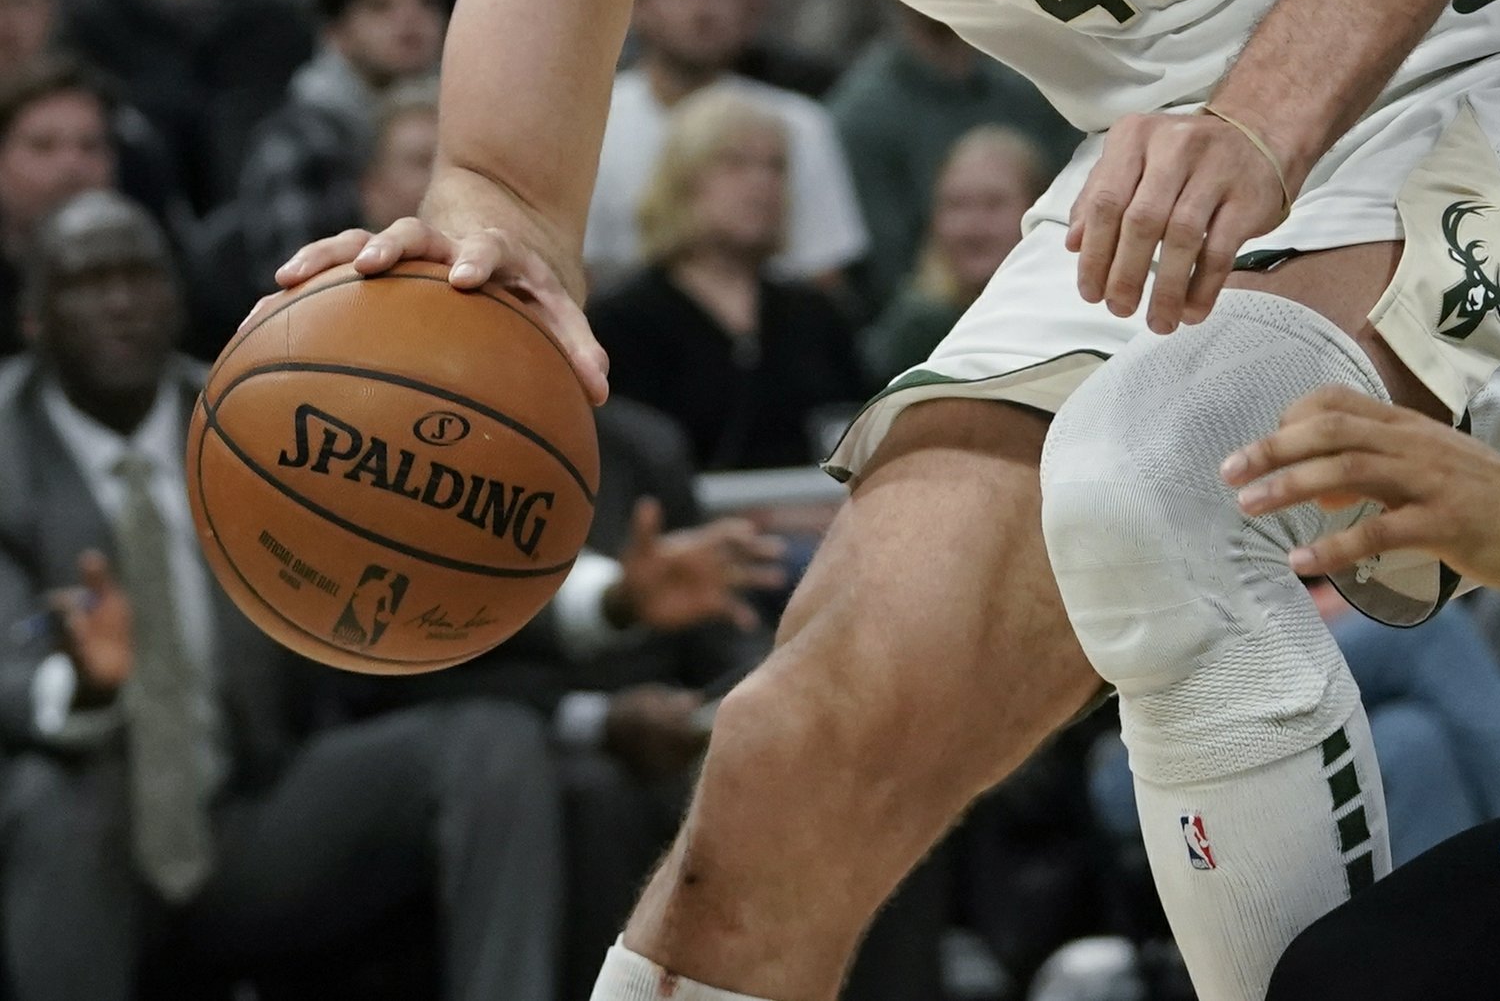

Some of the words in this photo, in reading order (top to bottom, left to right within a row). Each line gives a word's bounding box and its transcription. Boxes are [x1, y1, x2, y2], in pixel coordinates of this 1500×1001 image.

[278, 403, 555, 557] SPALDING
[259, 529, 295, 568] OFFICIAL
[291, 558, 320, 586] GAME
[316, 574, 341, 597] BALL
